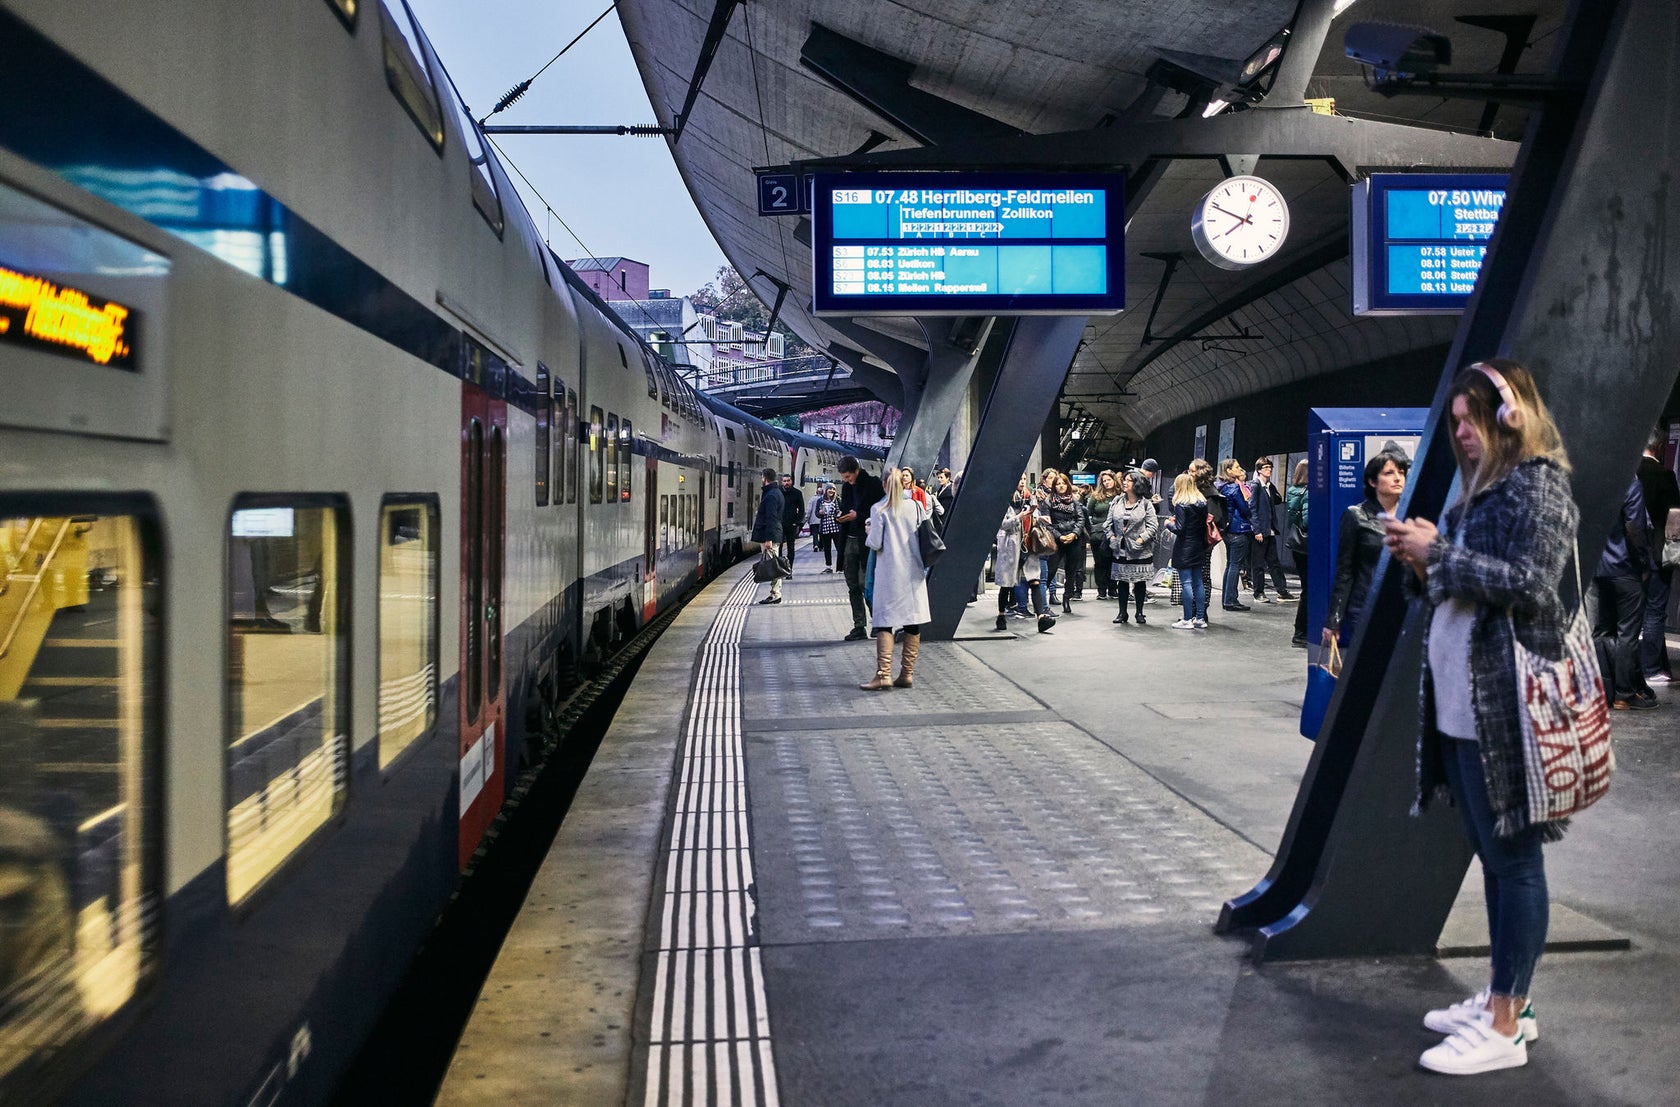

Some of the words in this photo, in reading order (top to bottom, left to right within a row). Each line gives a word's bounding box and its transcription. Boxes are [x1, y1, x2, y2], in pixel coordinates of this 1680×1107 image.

[772, 186, 787, 207] 2
[834, 191, 859, 202] S16
[875, 190, 919, 204] 07.48
[921, 190, 1094, 207] Herrliberg-Feldmeilen
[1428, 190, 1471, 206] 07.50
[1472, 190, 1506, 206] Win
[902, 207, 995, 219] Tiefenbrunnen
[1001, 207, 1053, 219] Zollikon
[867, 247, 894, 257] 07.53
[897, 247, 929, 257] Zürich
[930, 247, 945, 257] HB
[949, 247, 979, 257] Aarau
[1450, 247, 1475, 257] Uster
[897, 271, 929, 280] Zürich
[930, 271, 946, 280] HB
[1533, 715, 1579, 818] LOVE
